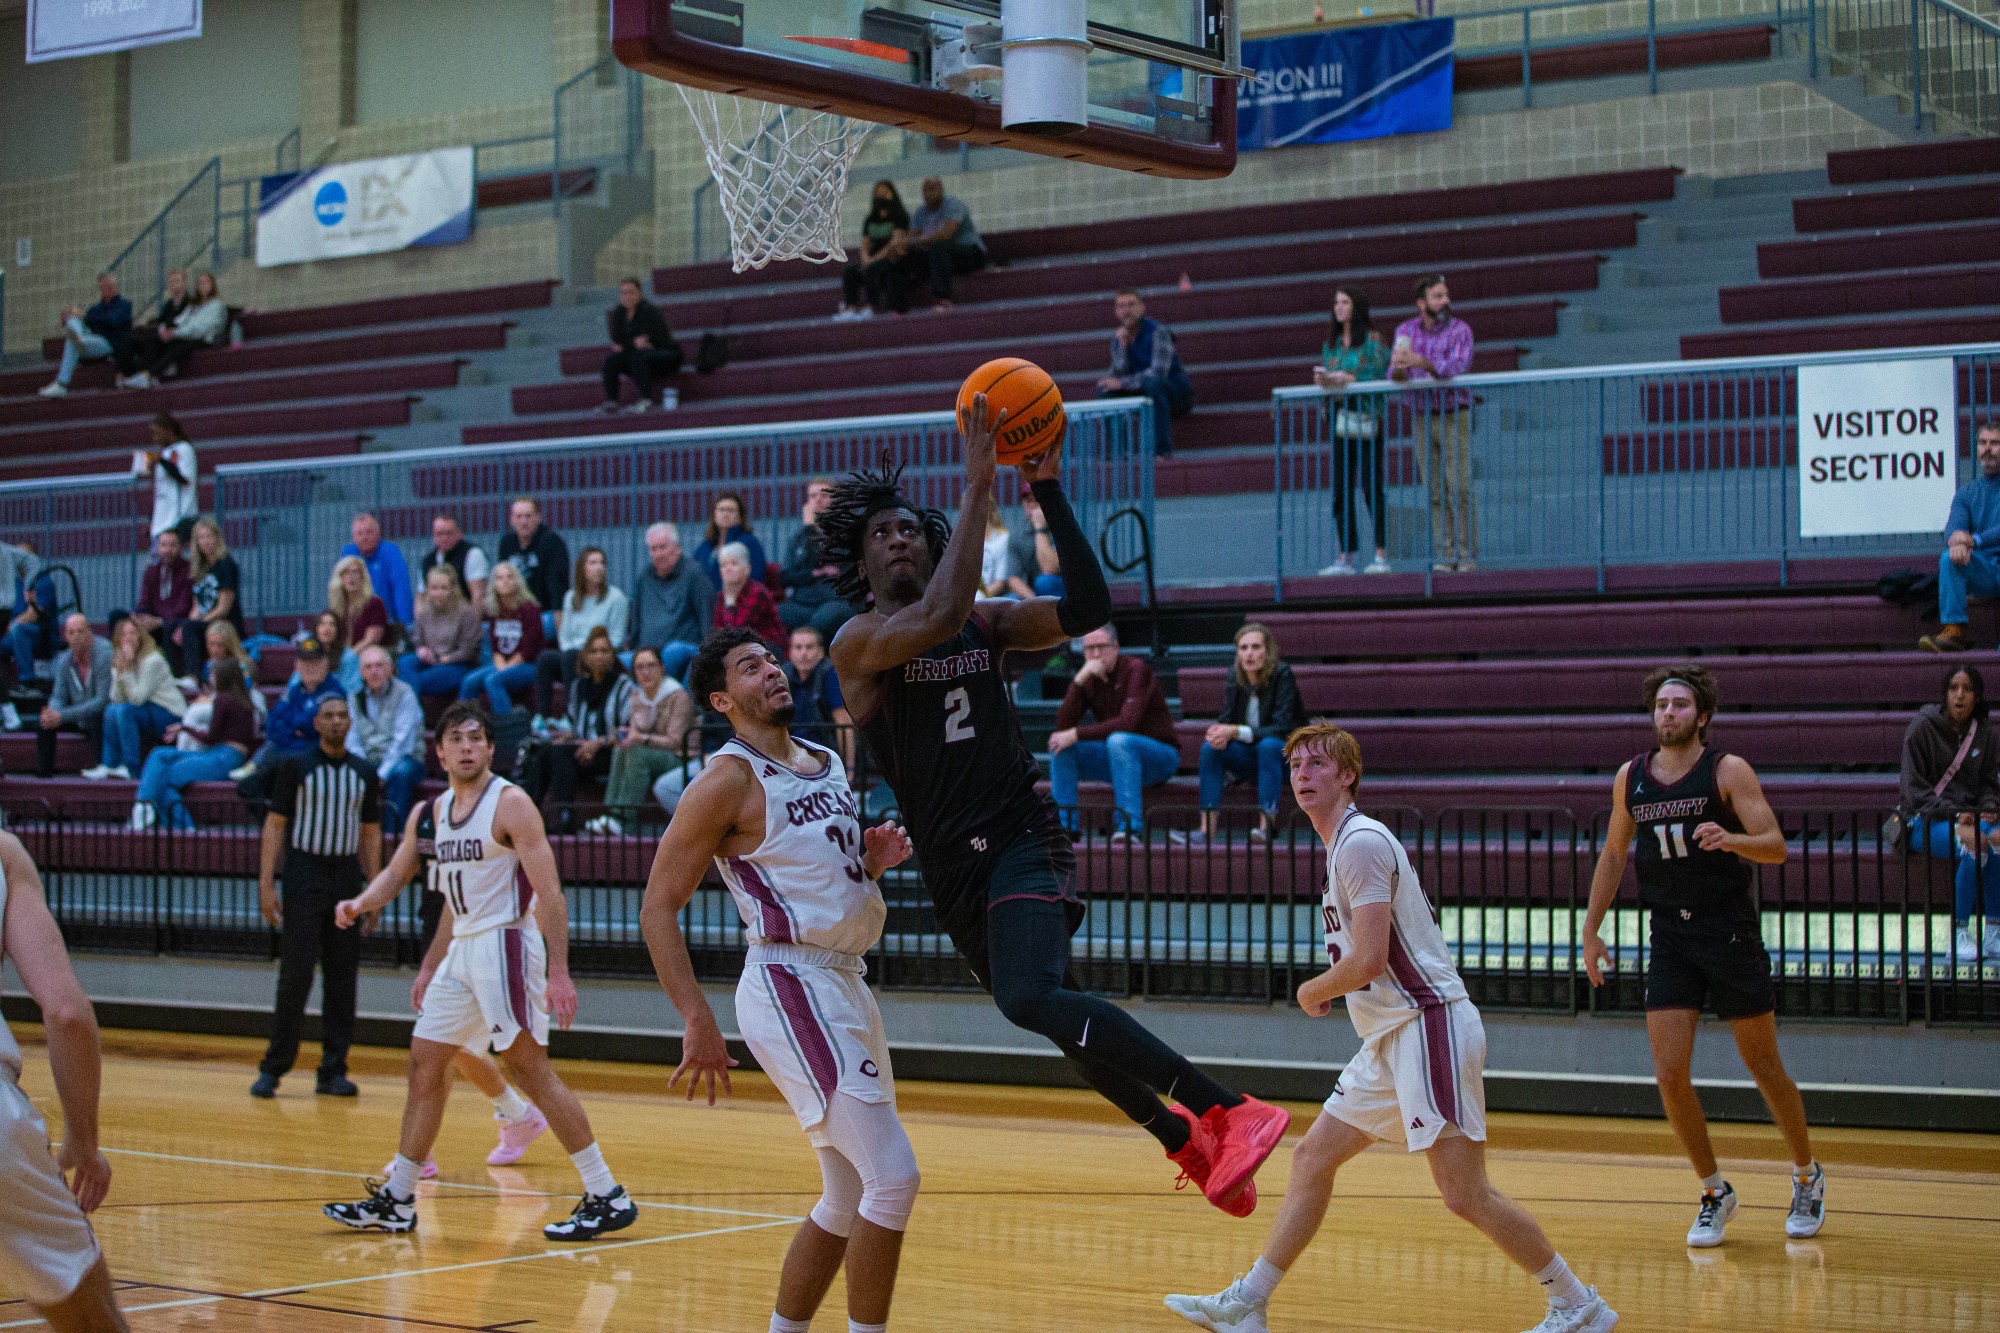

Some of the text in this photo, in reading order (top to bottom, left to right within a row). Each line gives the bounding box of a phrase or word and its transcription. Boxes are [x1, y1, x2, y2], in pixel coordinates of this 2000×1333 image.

[1321, 61, 1343, 87] III
[1813, 407, 1939, 439] VISITOR
[1810, 450, 1945, 483] SECTION
[904, 648, 990, 683] TRINITY
[944, 686, 976, 743] 2
[1632, 797, 1708, 823] TRINITY
[1653, 823, 1689, 860] 11
[447, 869, 469, 916] 11
